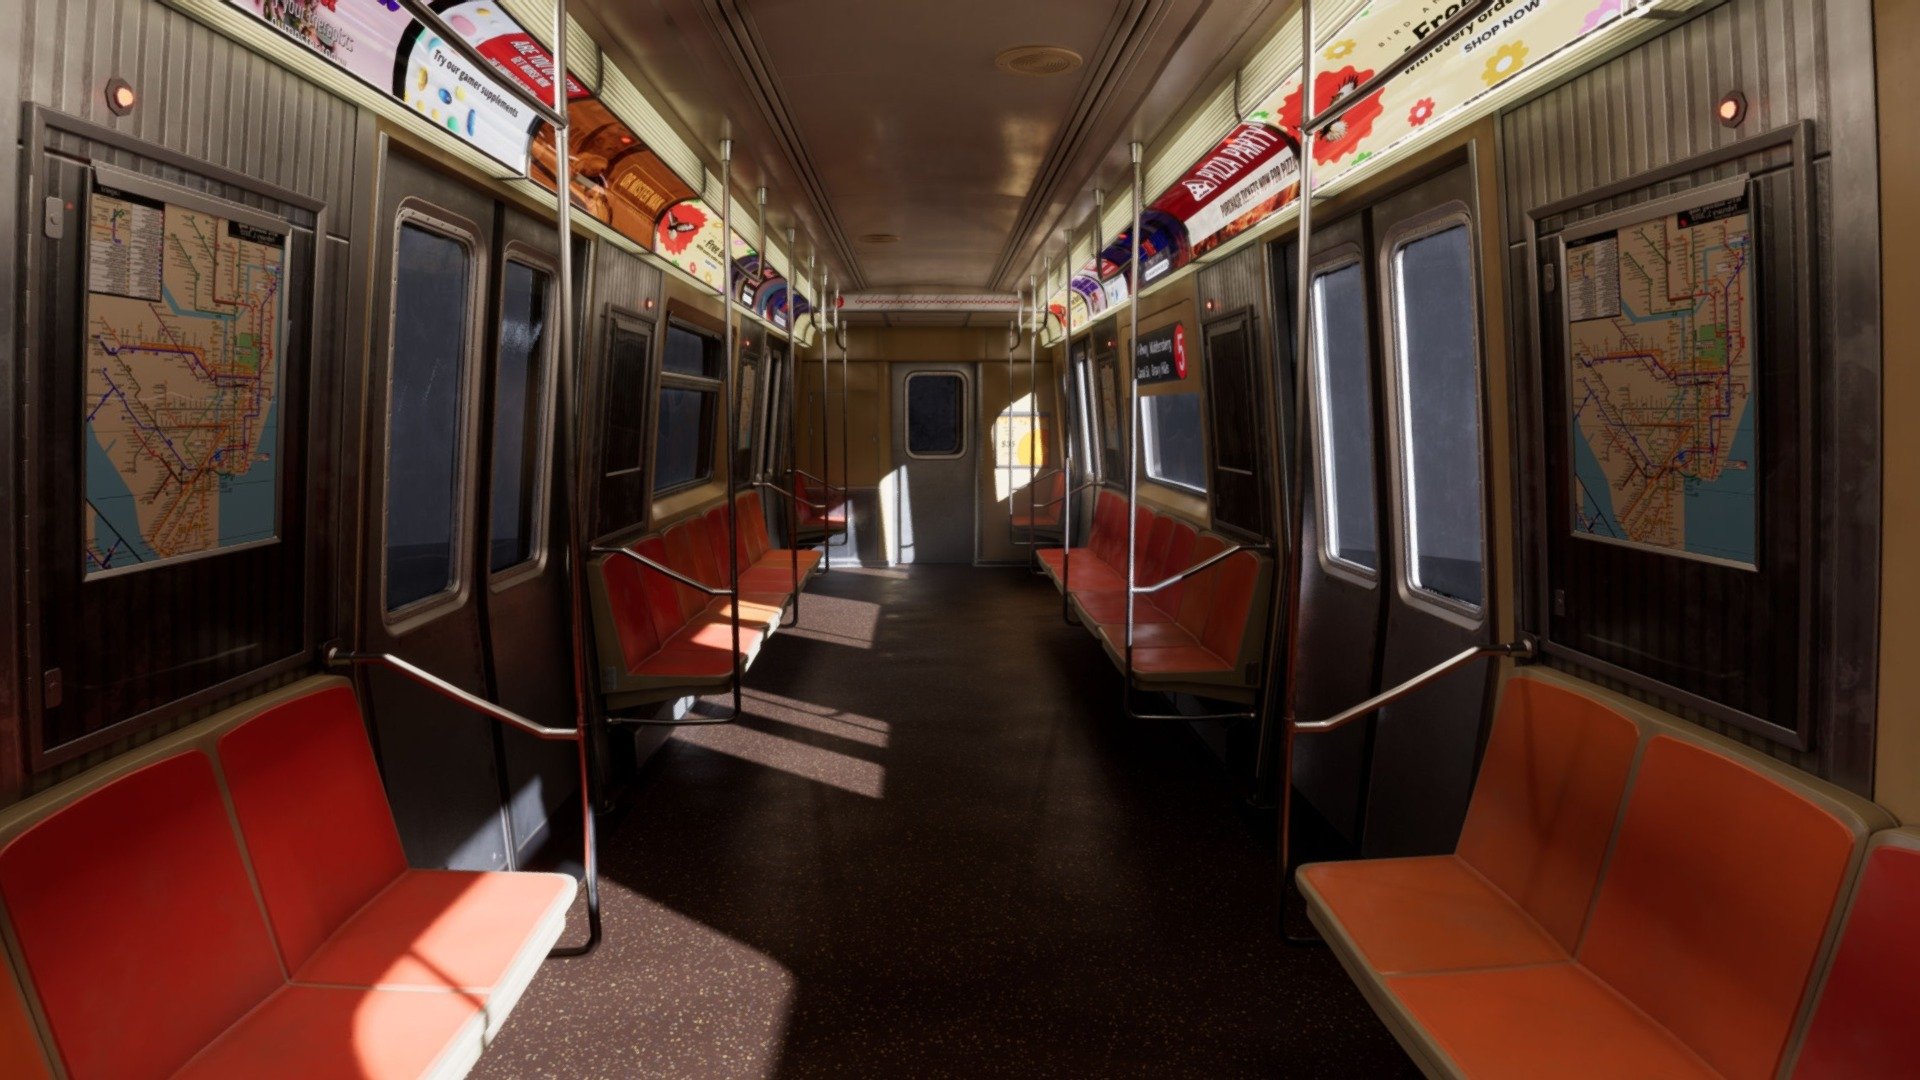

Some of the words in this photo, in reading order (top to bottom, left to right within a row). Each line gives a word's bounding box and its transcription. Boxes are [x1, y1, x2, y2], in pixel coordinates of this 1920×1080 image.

[1464, 24, 1500, 53] SHOP
[1502, 0, 1541, 28] NOW
[433, 49, 448, 67] Try
[446, 61, 461, 75] our
[458, 70, 482, 91] gamer
[481, 86, 519, 118] supplements
[1195, 156, 1243, 185] PIZZA
[1221, 125, 1278, 164] PARTY
[1177, 333, 1185, 372] 5
